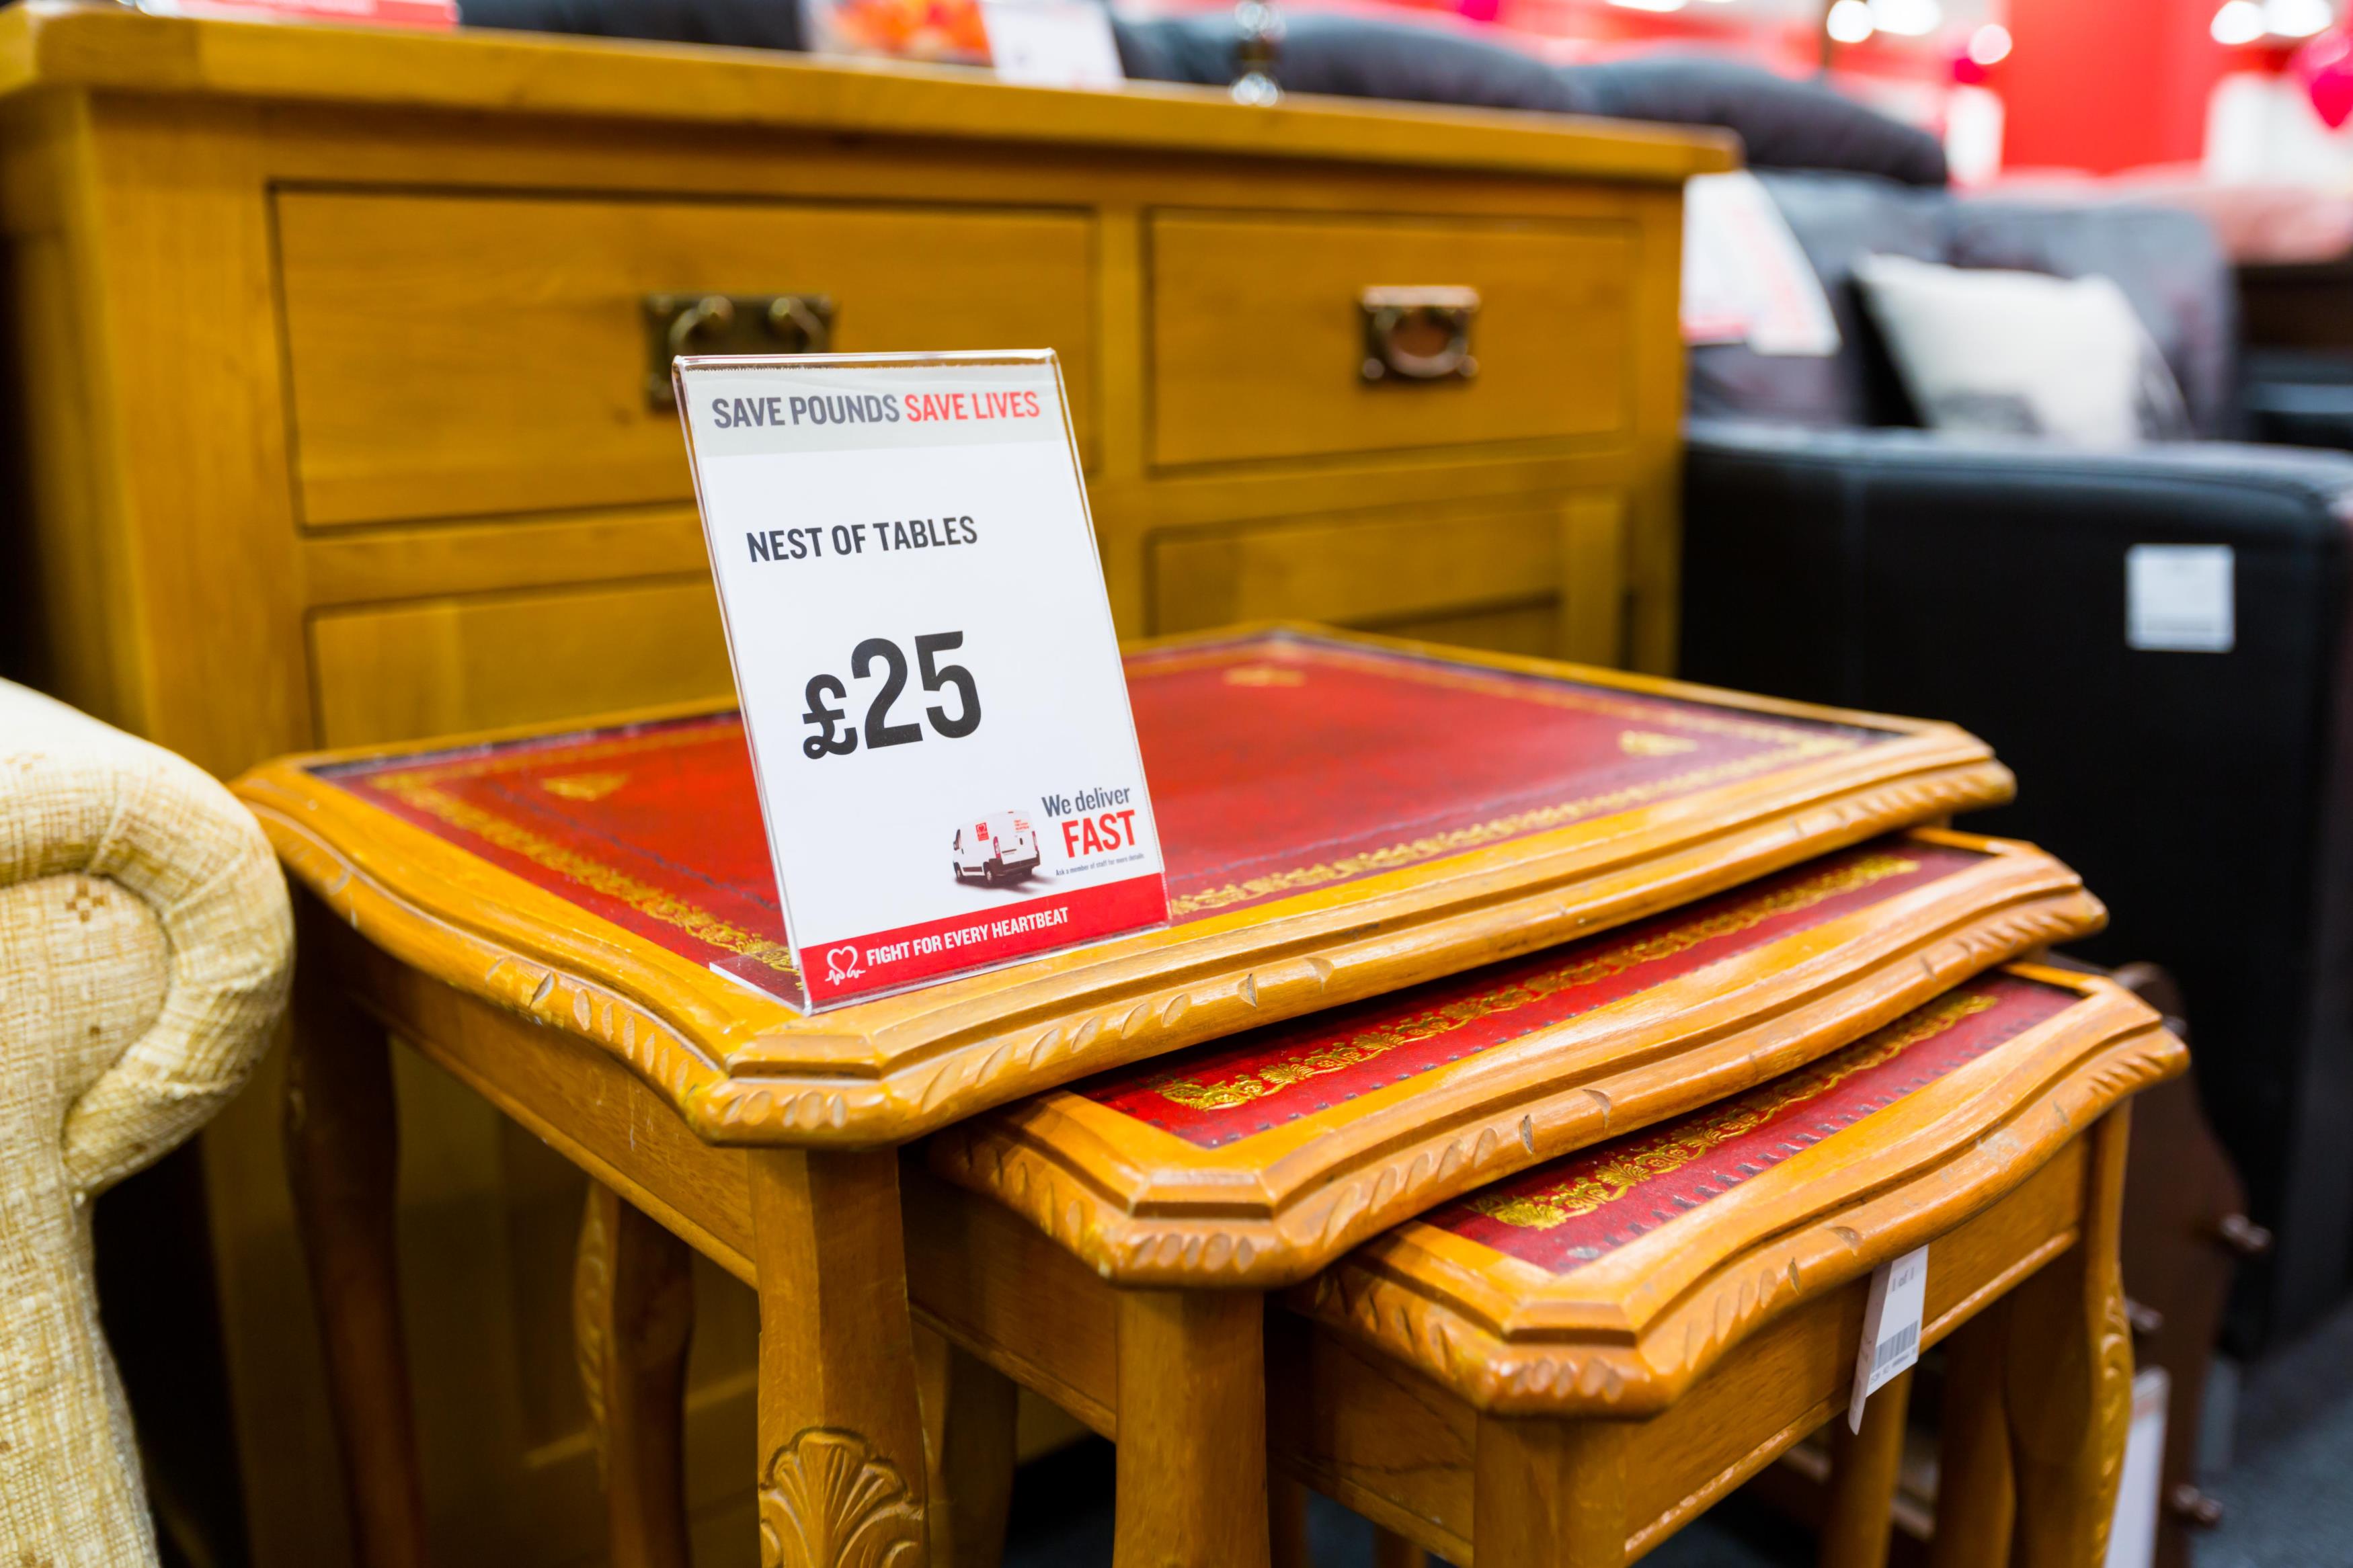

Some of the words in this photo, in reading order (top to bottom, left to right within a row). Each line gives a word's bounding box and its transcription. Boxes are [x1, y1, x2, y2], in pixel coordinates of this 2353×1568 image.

[712, 397, 786, 429] SAVE
[789, 394, 901, 425] POUNDS
[904, 393, 968, 422] SAVE
[971, 390, 1040, 419] LIVES
[746, 526, 824, 563] NEST
[831, 524, 866, 556] OF
[872, 515, 978, 551] TABLES
[801, 630, 982, 760] £25
[1041, 793, 1072, 818] We
[1075, 787, 1131, 812] deliver
[1061, 809, 1135, 858] FAST
[866, 941, 910, 966] FIGHT
[912, 935, 943, 956] FOR
[943, 924, 989, 949] EVERY
[992, 907, 1069, 938] HEARTBEAT
